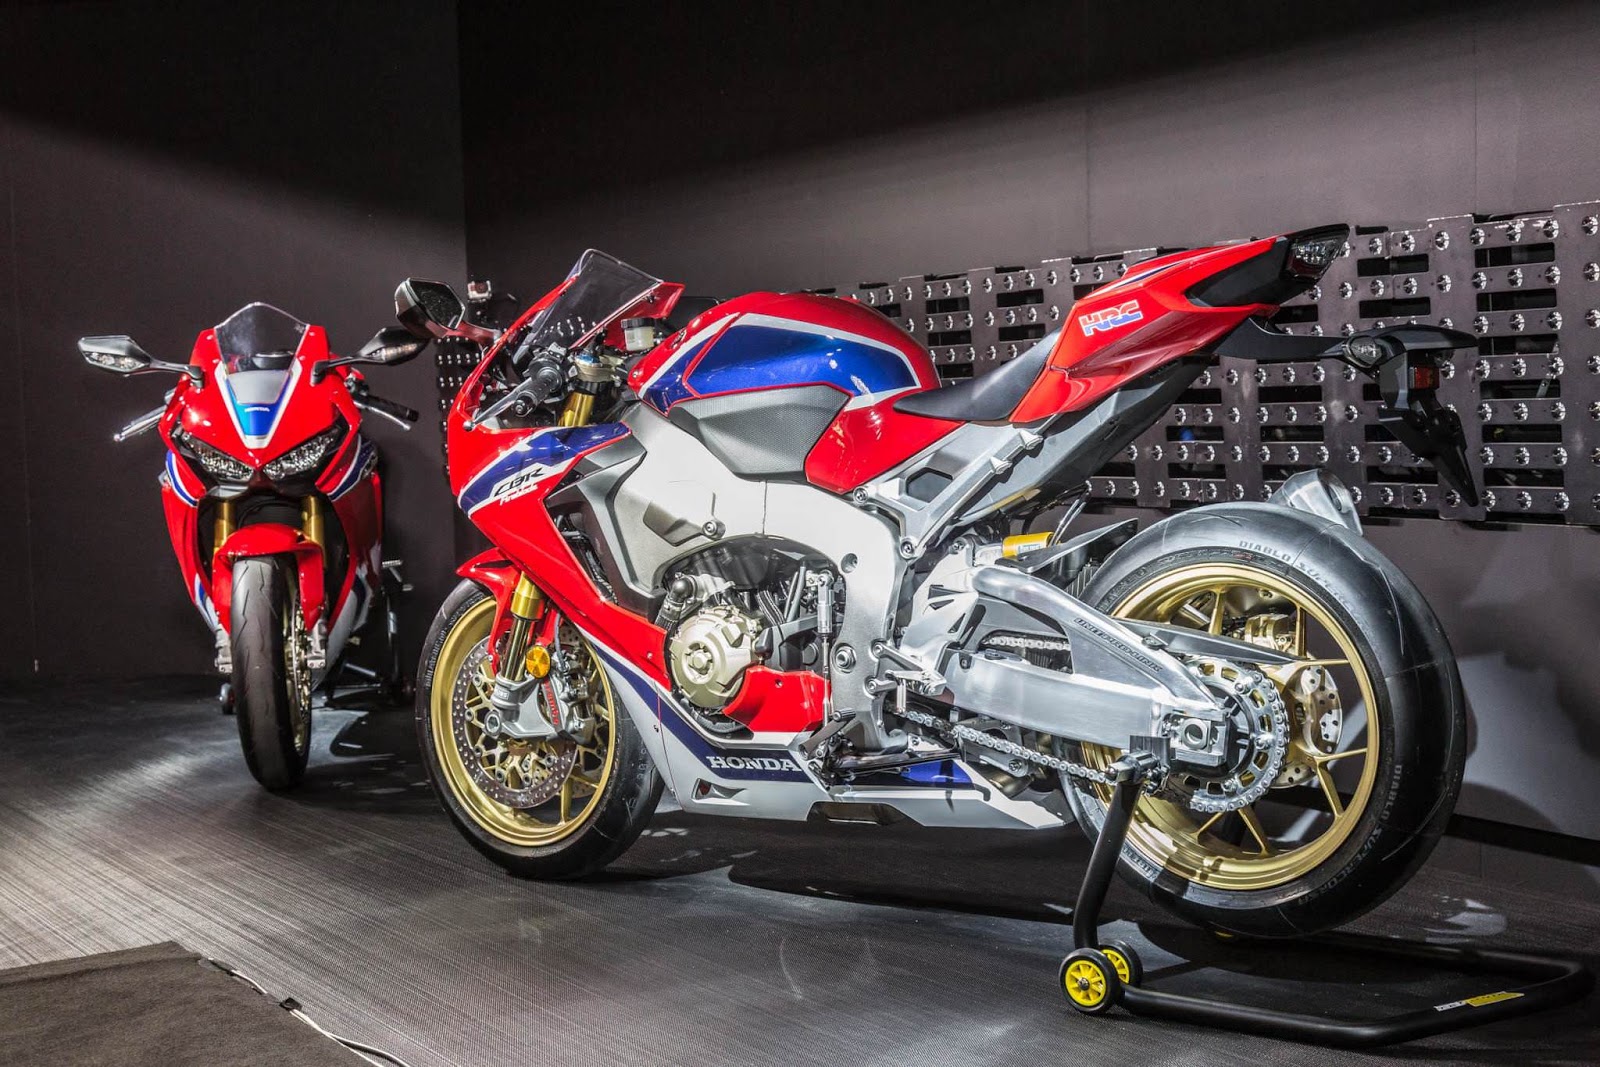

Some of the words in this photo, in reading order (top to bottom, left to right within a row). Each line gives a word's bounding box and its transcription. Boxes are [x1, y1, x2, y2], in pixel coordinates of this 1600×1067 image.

[1078, 299, 1144, 337] HRC
[494, 466, 544, 497] CBR
[1238, 540, 1292, 562] DIABLO
[706, 755, 802, 772] HONDA
[1381, 764, 1403, 820] DIABLO
